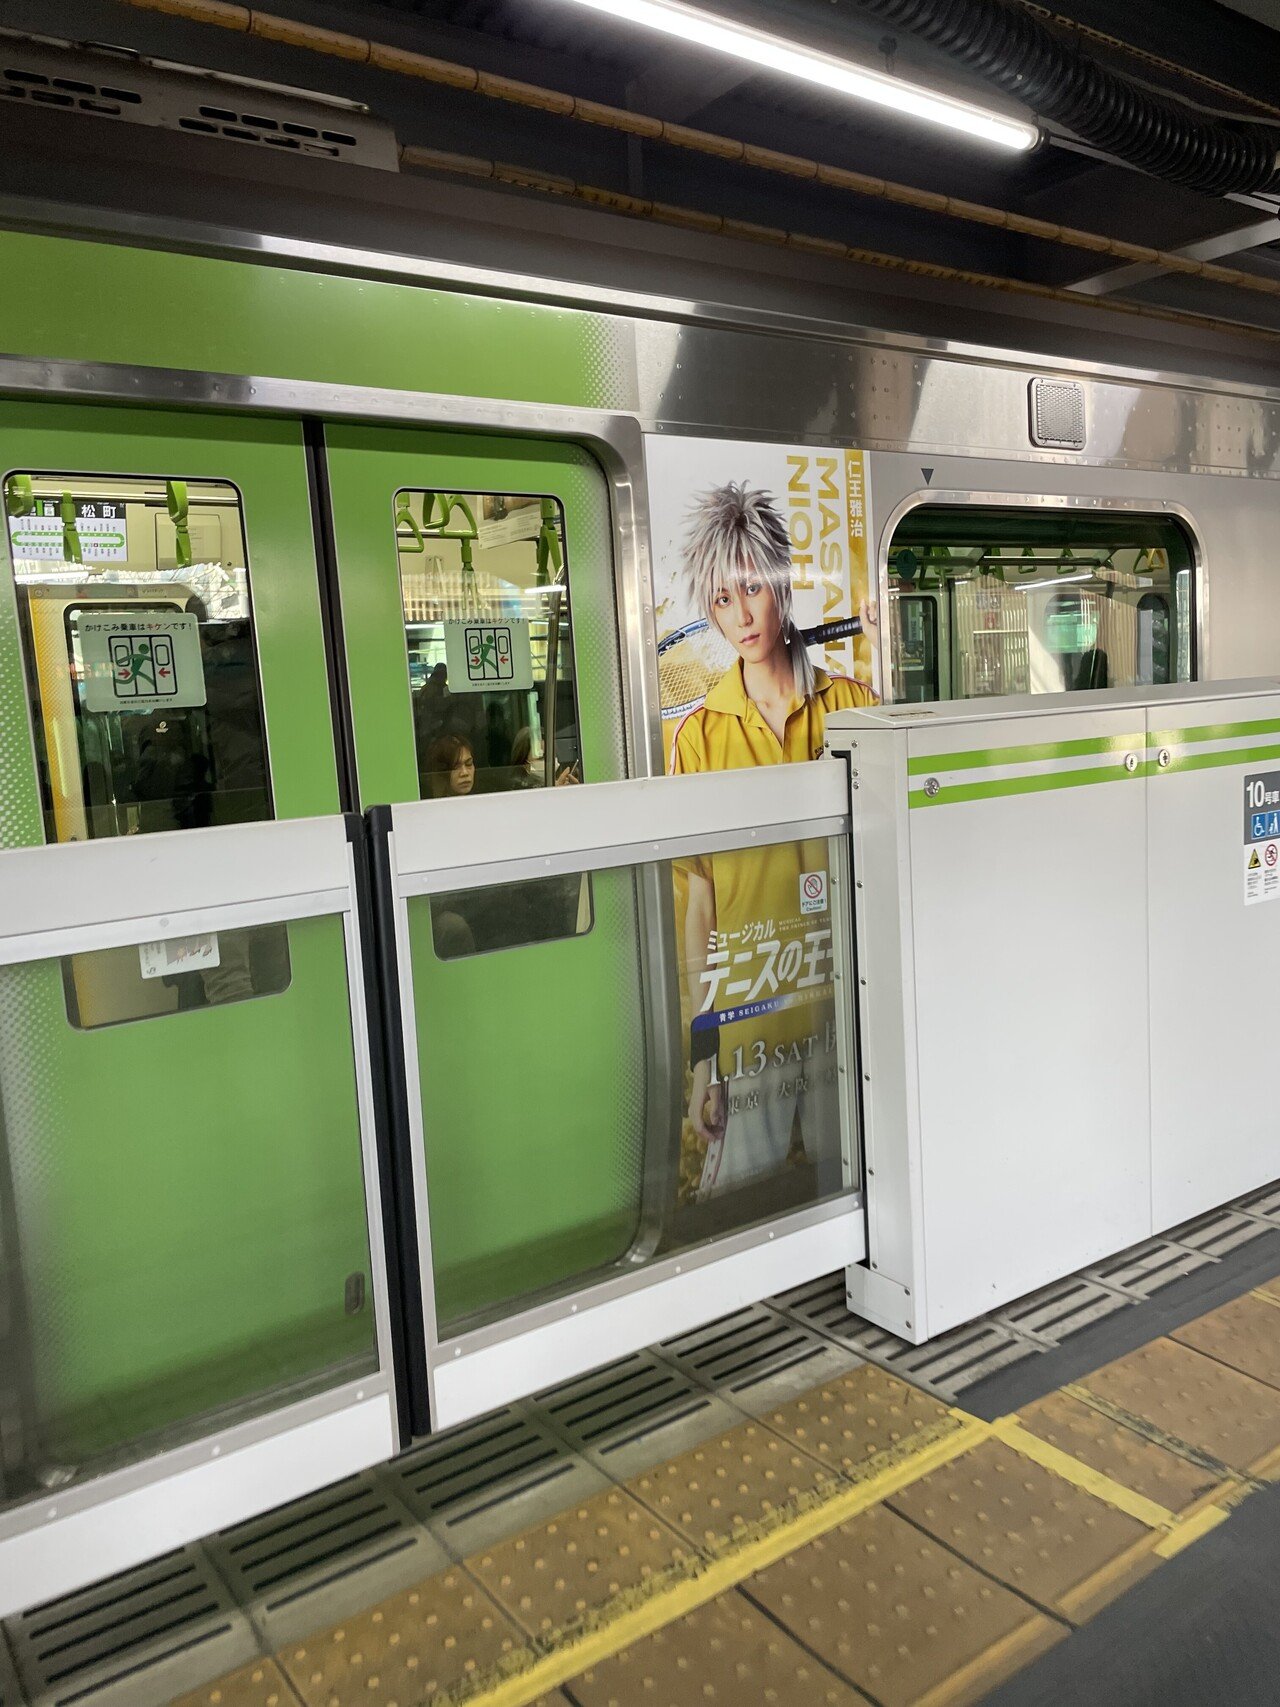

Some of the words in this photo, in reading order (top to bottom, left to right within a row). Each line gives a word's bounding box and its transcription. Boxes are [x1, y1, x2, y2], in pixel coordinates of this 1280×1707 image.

[848, 460, 863, 537] 仁王雅治
[787, 455, 815, 590] NIOH
[707, 919, 776, 950] ミュージカル
[719, 1010, 735, 1022] 青学
[706, 1040, 767, 1087] 1.13
[773, 1035, 818, 1068] SAT
[779, 1077, 808, 1099] 大阪
